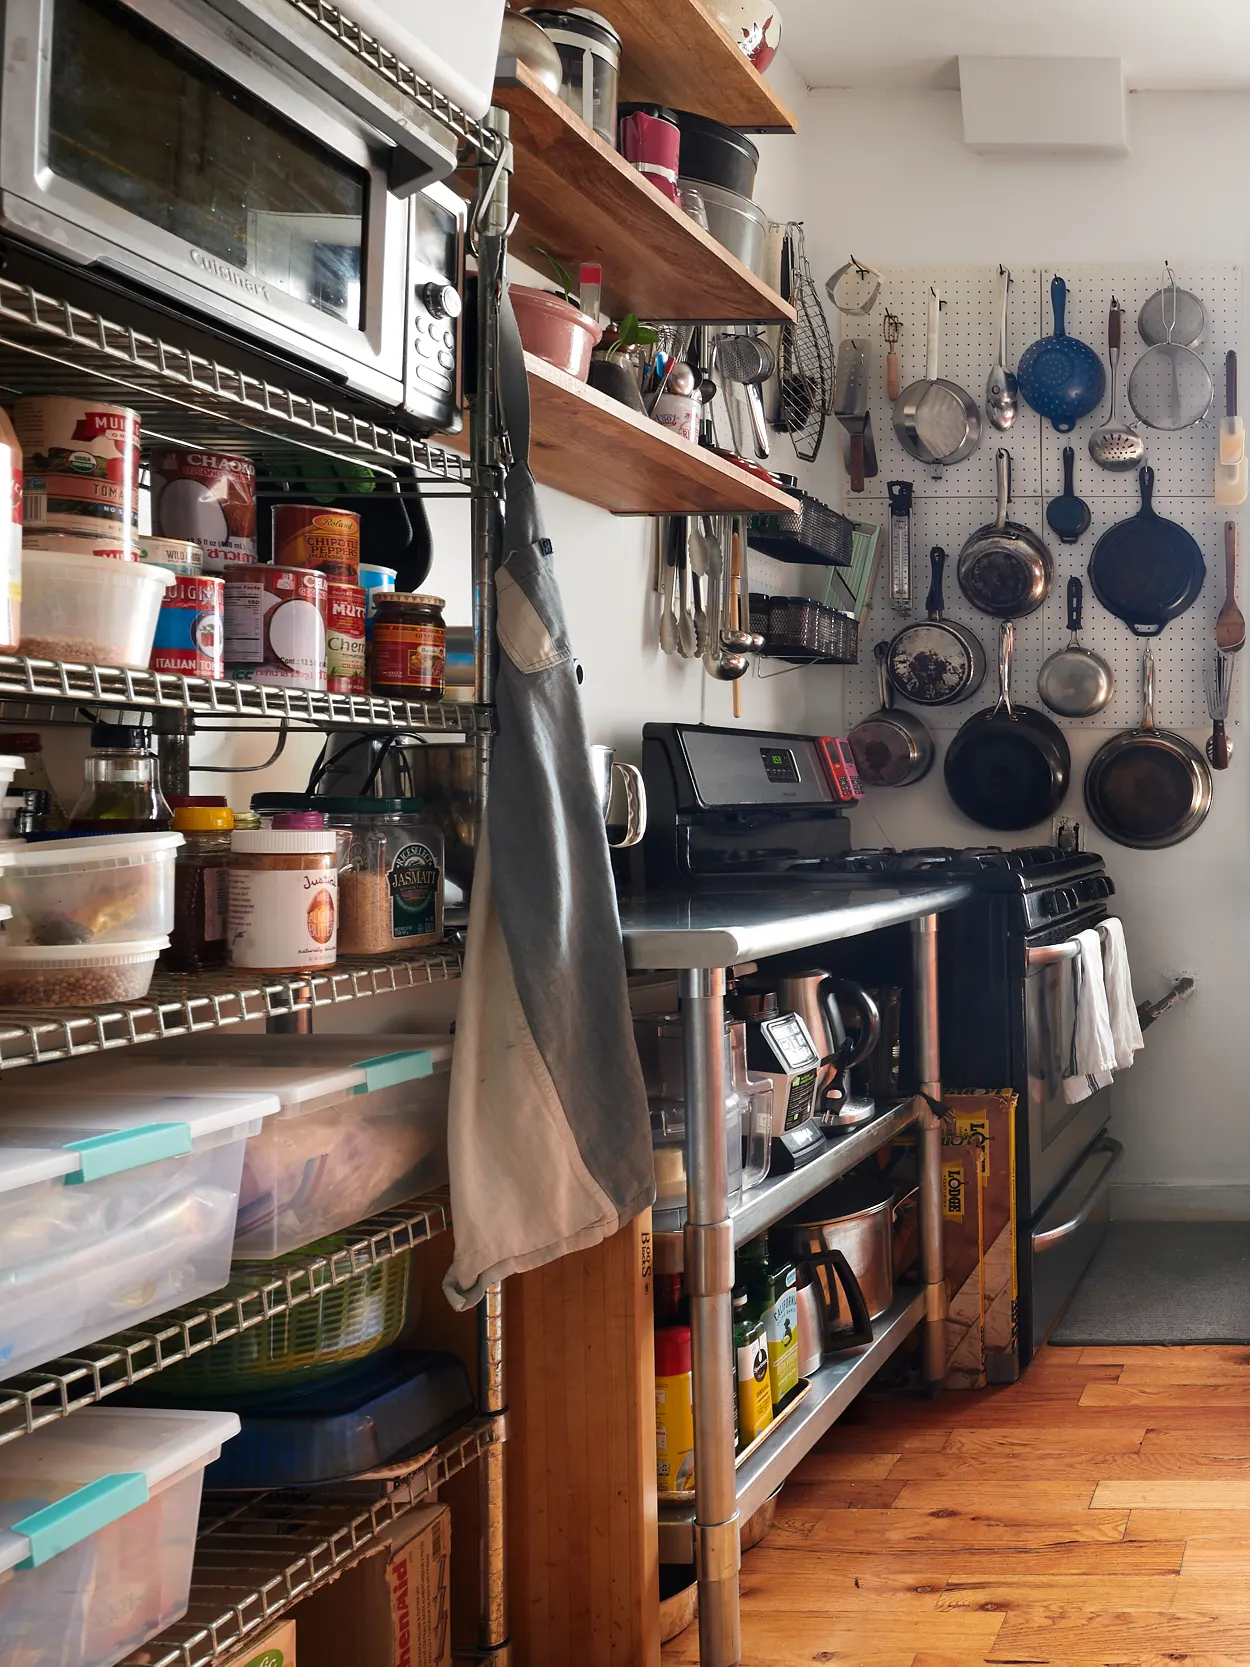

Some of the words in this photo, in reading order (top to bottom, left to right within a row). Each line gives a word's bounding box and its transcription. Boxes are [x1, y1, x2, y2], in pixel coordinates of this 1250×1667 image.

[190, 249, 272, 304] Cuisinart
[74, 455, 92, 463] USDA
[186, 454, 256, 476] CHAOKO
[103, 505, 116, 513] NO
[323, 517, 353, 530] Roland
[166, 549, 185, 561] WILD
[311, 545, 358, 557] PEPPERS
[332, 603, 366, 618] MUTT
[155, 658, 196, 670] ITALIAN
[392, 870, 436, 888] JASMATI
[948, 1170, 961, 1212] LODGE
